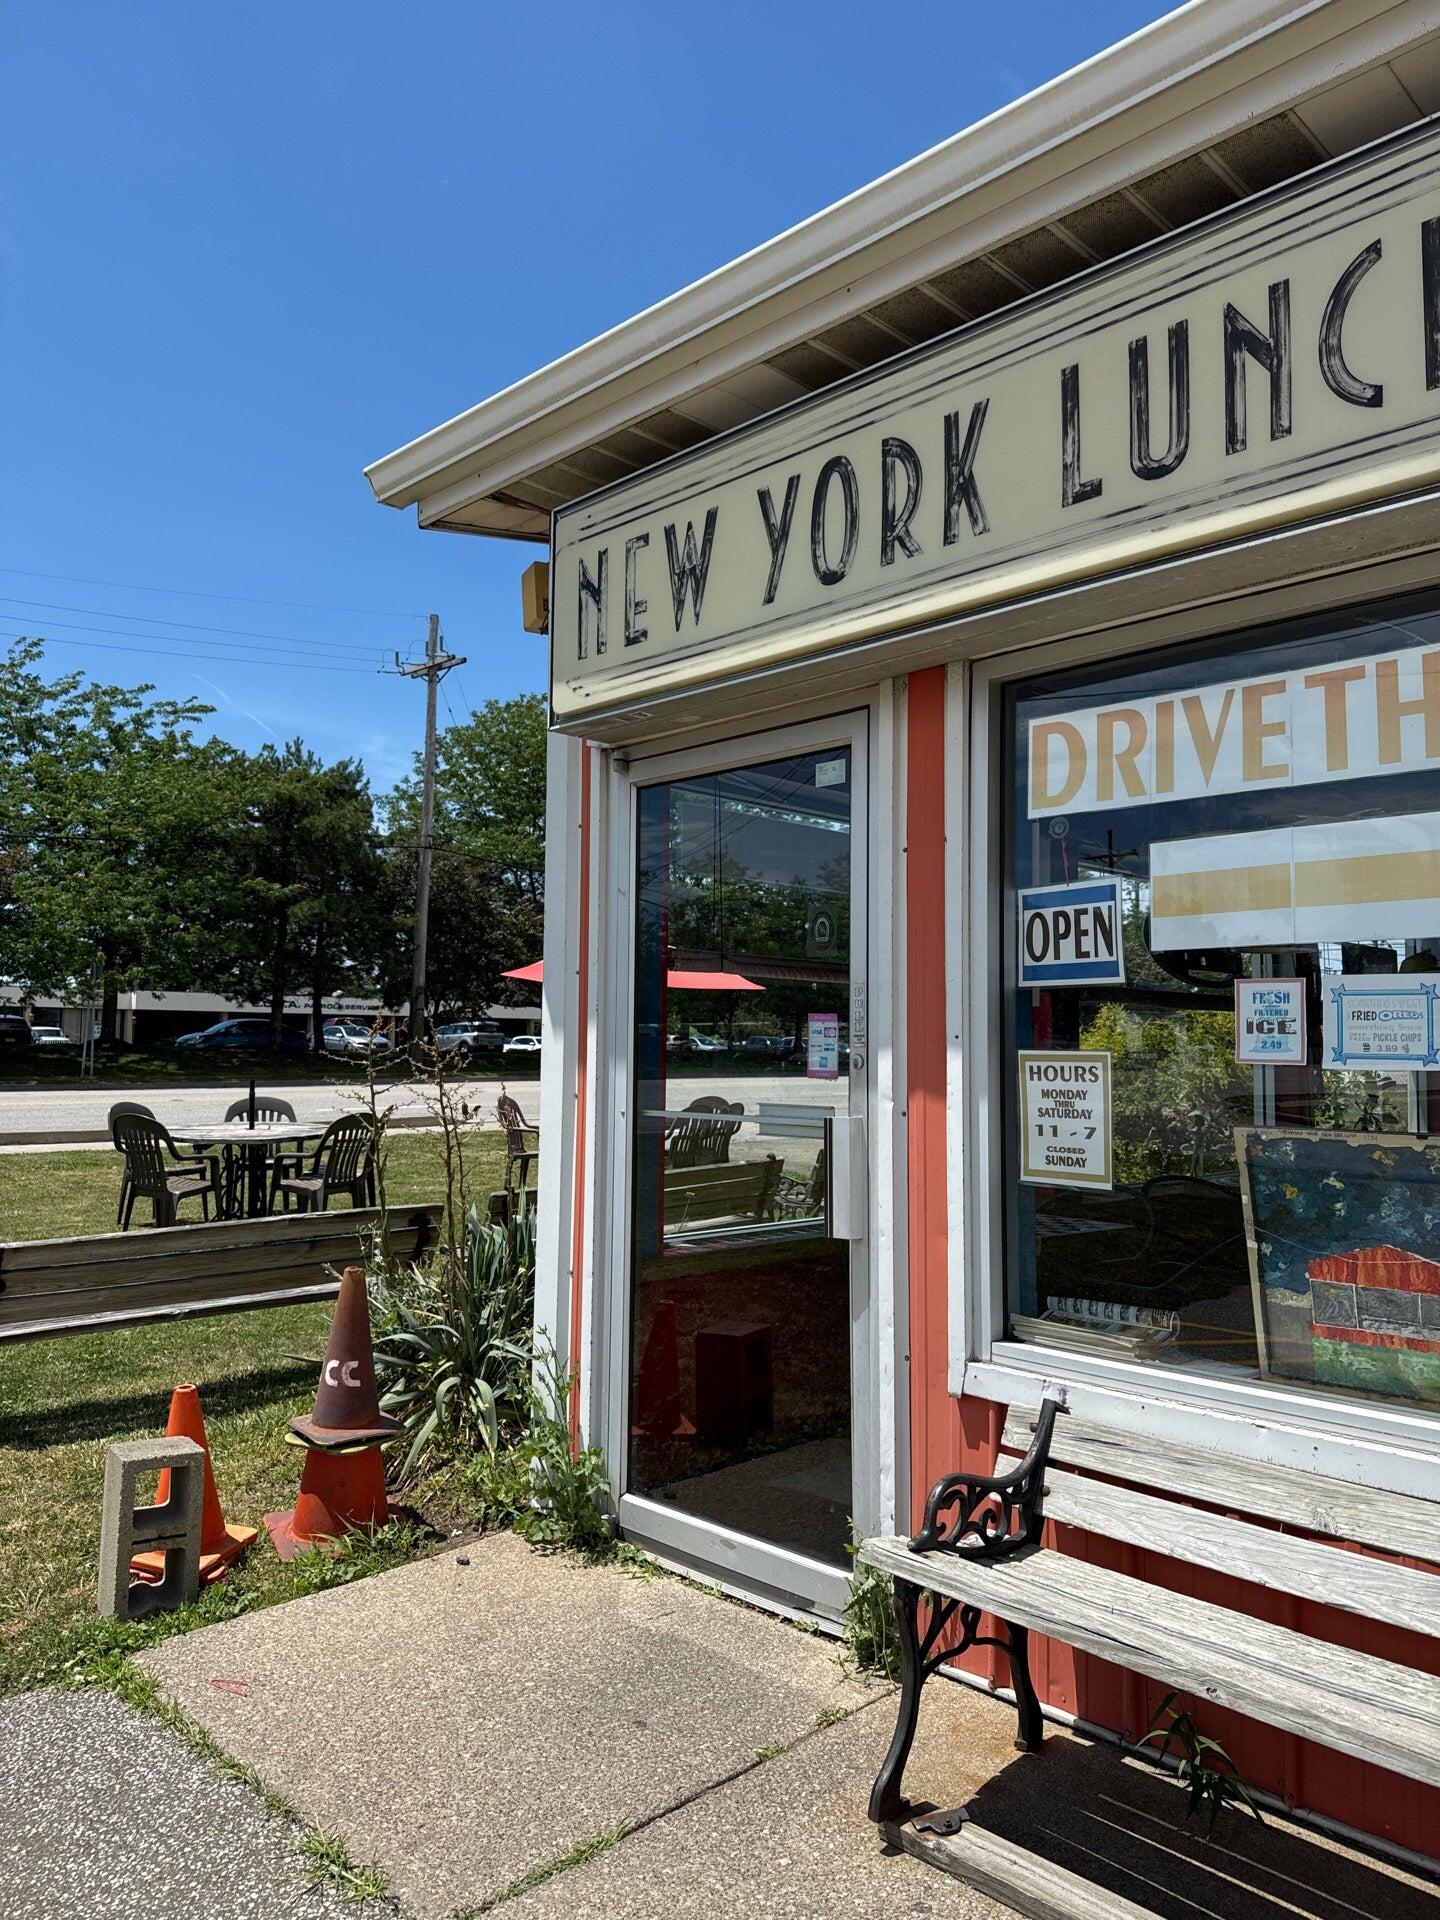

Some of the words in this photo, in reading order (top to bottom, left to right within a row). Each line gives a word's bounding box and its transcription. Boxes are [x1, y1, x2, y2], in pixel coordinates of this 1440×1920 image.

[576, 505, 719, 661] NEW
[756, 397, 991, 606] YORK
[1031, 679, 1290, 810] DRIVE
[1304, 651, 1440, 772] TH
[1025, 904, 1115, 963] OPEN
[1252, 991, 1291, 1005] FRESH
[1254, 1009, 1289, 1017] FILTERED
[1351, 1010, 1377, 1021] FRIED
[1246, 1017, 1297, 1035] ICE
[1373, 1033, 1398, 1042] PICKLE
[1400, 1033, 1422, 1043] CHIPS
[1261, 1040, 1282, 1050] 2.49
[1376, 1044, 1398, 1053] 3.89
[1028, 1064, 1100, 1083] HOURS
[1041, 1088, 1089, 1101] MONDAY
[1054, 1100, 1075, 1109] THRU
[1037, 1107, 1093, 1120] SATURDAY
[1046, 1145, 1086, 1155] CLOSED
[1045, 1154, 1088, 1168] SUNDAY
[324, 1359, 361, 1388] CC
